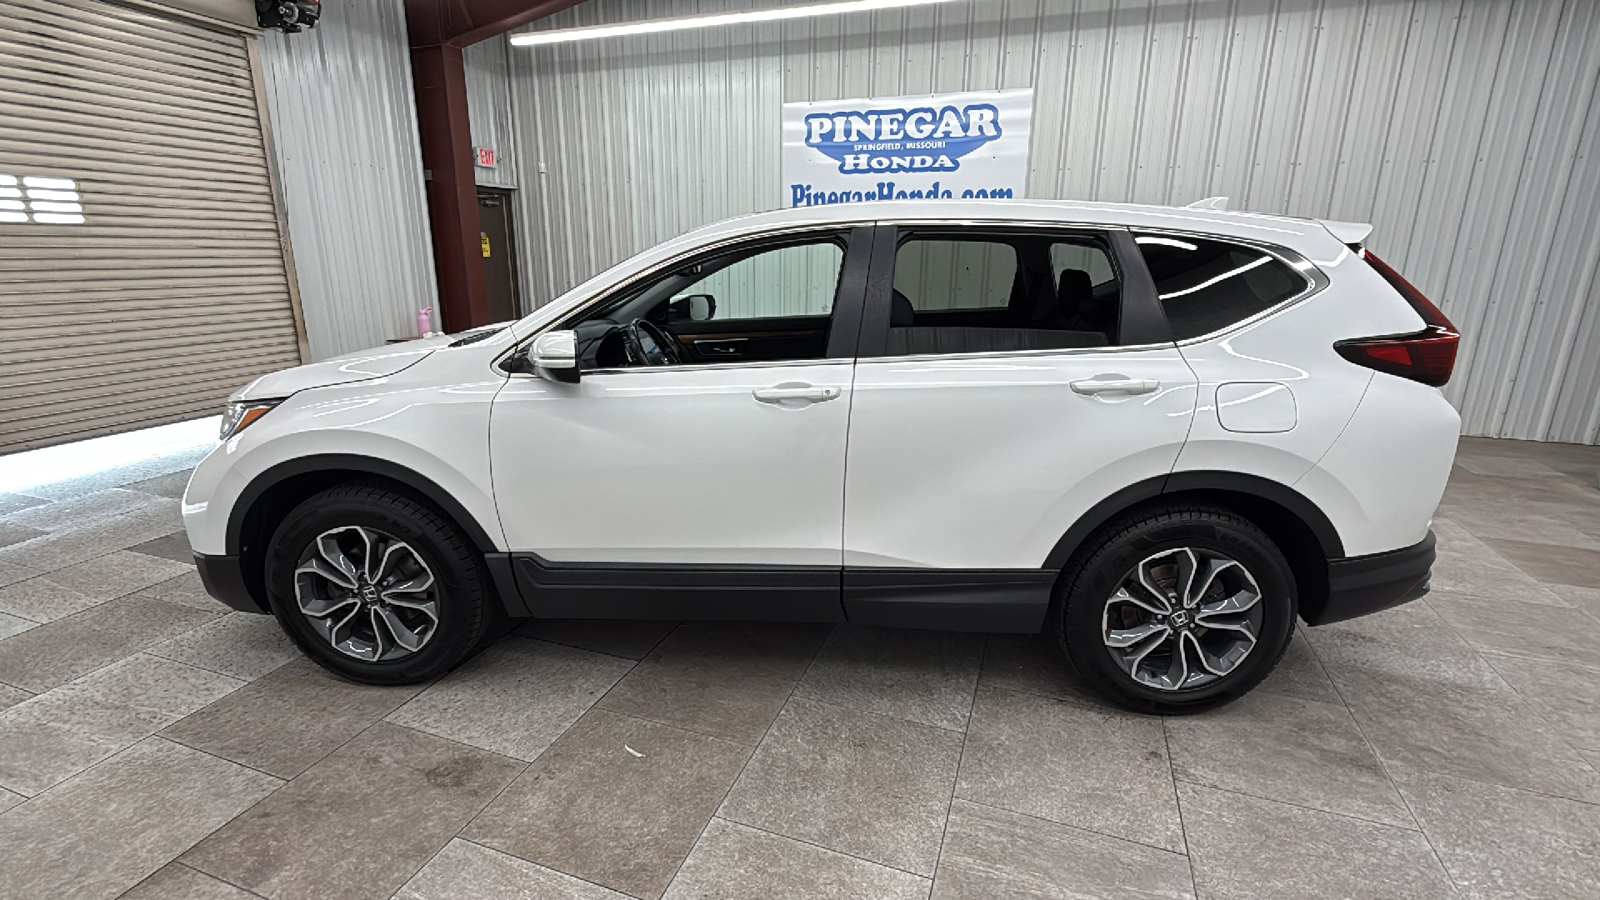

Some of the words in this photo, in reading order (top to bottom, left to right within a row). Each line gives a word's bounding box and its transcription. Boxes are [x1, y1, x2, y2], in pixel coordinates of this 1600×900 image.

[808, 109, 998, 143] PINEGAR
[853, 142, 904, 151] SPRINGFIELD,
[906, 141, 946, 150] MISSOURI
[480, 148, 494, 165] EXIT
[842, 154, 955, 170] HONDA
[791, 182, 1013, 207] PinegarHondacom
